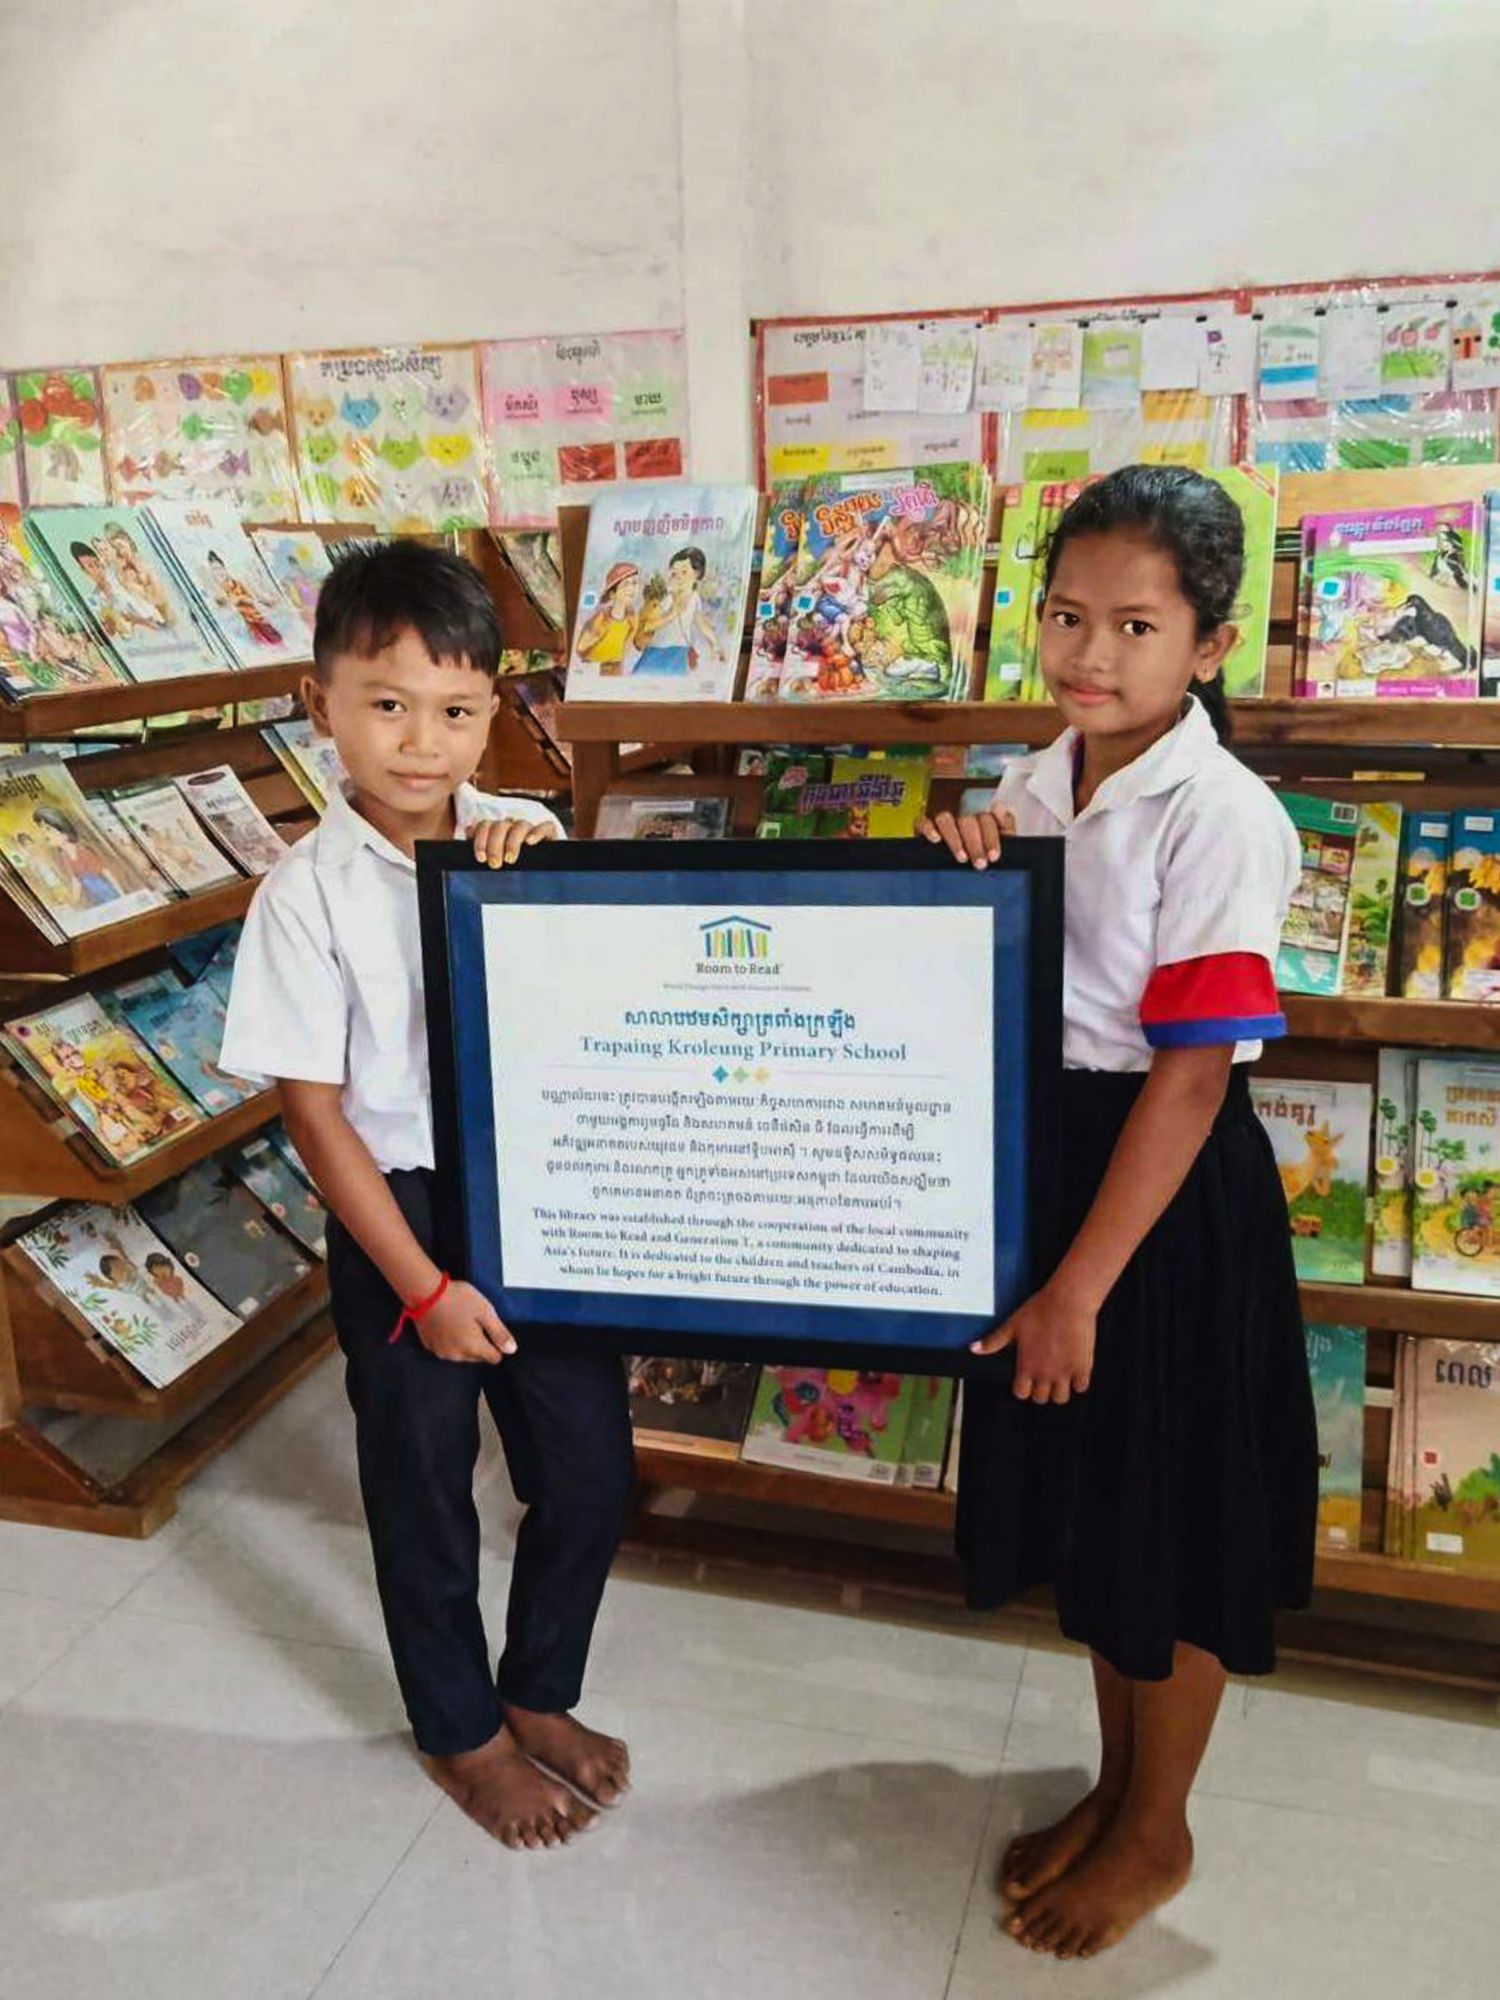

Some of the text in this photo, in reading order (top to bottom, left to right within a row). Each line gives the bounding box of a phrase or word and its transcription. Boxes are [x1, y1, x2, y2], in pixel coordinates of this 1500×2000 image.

[696, 963, 732, 975] Room
[734, 964, 747, 975] to
[580, 1036, 907, 1061] Trapaing Kroleung Primary School
[533, 1207, 969, 1241] This library was established through the cooperation of the local community
[541, 1227, 566, 1238] with
[569, 1228, 601, 1240] Room
[605, 1230, 617, 1240] to
[620, 1230, 648, 1242] Read
[650, 1232, 671, 1243] and
[674, 1233, 739, 1247] Generation
[765, 1240, 833, 1253] community
[836, 1242, 894, 1255] dedicated
[897, 1246, 909, 1255] to
[912, 1247, 961, 1261] shaping
[618, 1249, 629, 1259] It
[631, 1250, 641, 1260] is
[643, 1250, 697, 1263] dedicated
[700, 1253, 712, 1263] to
[715, 1253, 733, 1265] the
[735, 1255, 784, 1269] children
[787, 1257, 808, 1269] and
[811, 1259, 860, 1272] teachers
[862, 1262, 874, 1273] of
[878, 1264, 944, 1279] Cambodia,
[947, 1267, 960, 1278] in
[560, 1264, 594, 1275] whom
[613, 1266, 645, 1280] hopes
[648, 1267, 665, 1278] for
[676, 1269, 712, 1284] bright
[715, 1271, 750, 1284] future
[753, 1275, 800, 1289] through
[803, 1276, 821, 1289] the
[824, 1279, 861, 1293] power
[863, 1280, 875, 1292] of
[878, 1283, 943, 1296] education.
